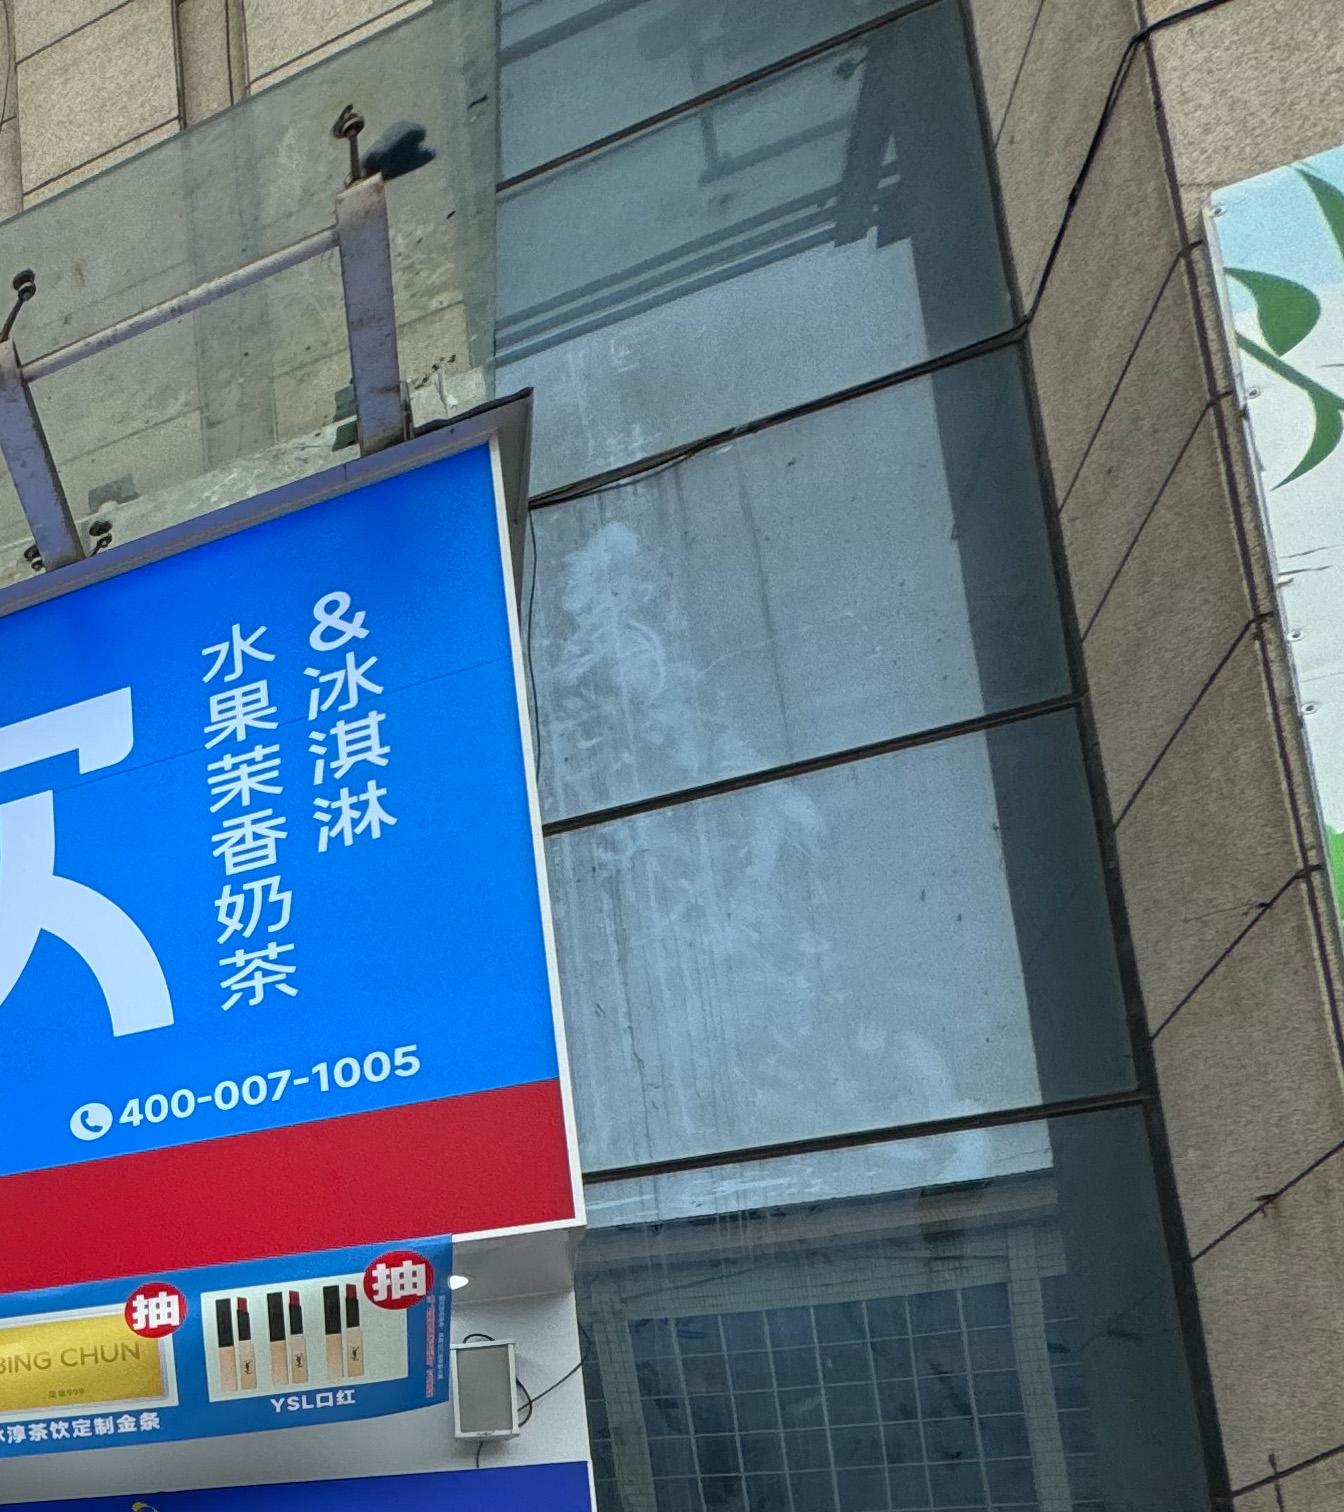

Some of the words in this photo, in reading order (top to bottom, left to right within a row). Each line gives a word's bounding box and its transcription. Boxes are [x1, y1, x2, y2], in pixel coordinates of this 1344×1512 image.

[304, 590, 398, 852] &冰淇淋
[201, 624, 298, 1011] 水果茉香奶茶
[118, 1045, 421, 1126] 400-007-1005
[372, 1260, 427, 1302] 抽
[132, 1291, 181, 1330] 抽
[61, 1341, 140, 1367] CHUN
[270, 1389, 356, 1413] YSL口红
